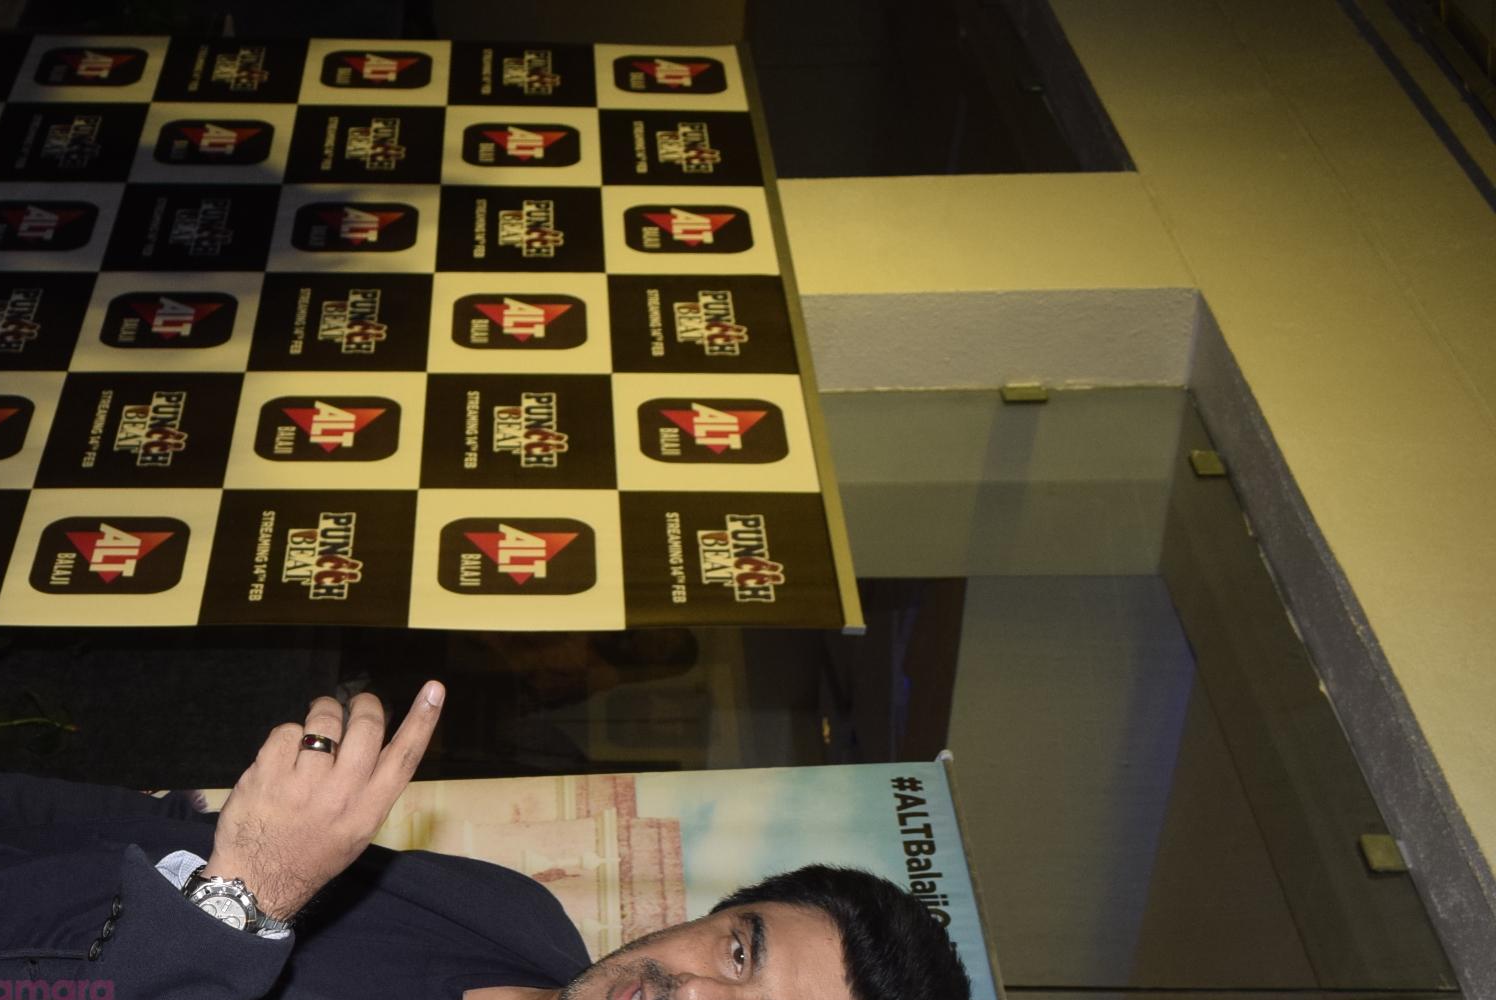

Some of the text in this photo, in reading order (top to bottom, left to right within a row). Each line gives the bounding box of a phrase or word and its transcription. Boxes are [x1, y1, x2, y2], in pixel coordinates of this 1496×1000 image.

[74, 50, 112, 77] ALT
[361, 54, 397, 80] ALT
[653, 59, 690, 85] ALT
[196, 123, 237, 155] ALT
[506, 127, 542, 157] ALT
[15, 204, 59, 239] ALT
[338, 206, 378, 240] ALT
[670, 208, 712, 242] ALT
[150, 296, 195, 335] ALT
[318, 301, 347, 340] BEAT
[502, 298, 544, 336] ALT
[646, 289, 661, 328] STREAMING
[674, 303, 703, 342] BEAT
[650, 342, 663, 356] FEB
[89, 390, 114, 435] STREAMING
[113, 406, 149, 451] BEAT
[307, 401, 355, 446] ALT
[465, 391, 479, 435] STREAMING
[493, 407, 520, 451] BEAT
[690, 403, 740, 448] ALT
[80, 452, 97, 468] FEB
[463, 452, 477, 468] FEB
[87, 523, 141, 576] ALT
[254, 511, 275, 563] STREAMING
[282, 529, 316, 582] BEAT
[496, 524, 545, 577] ALT
[665, 512, 683, 564] STREAMING
[698, 531, 732, 584] BEAT
[247, 583, 264, 602] FEB
[670, 585, 686, 604] FEB
